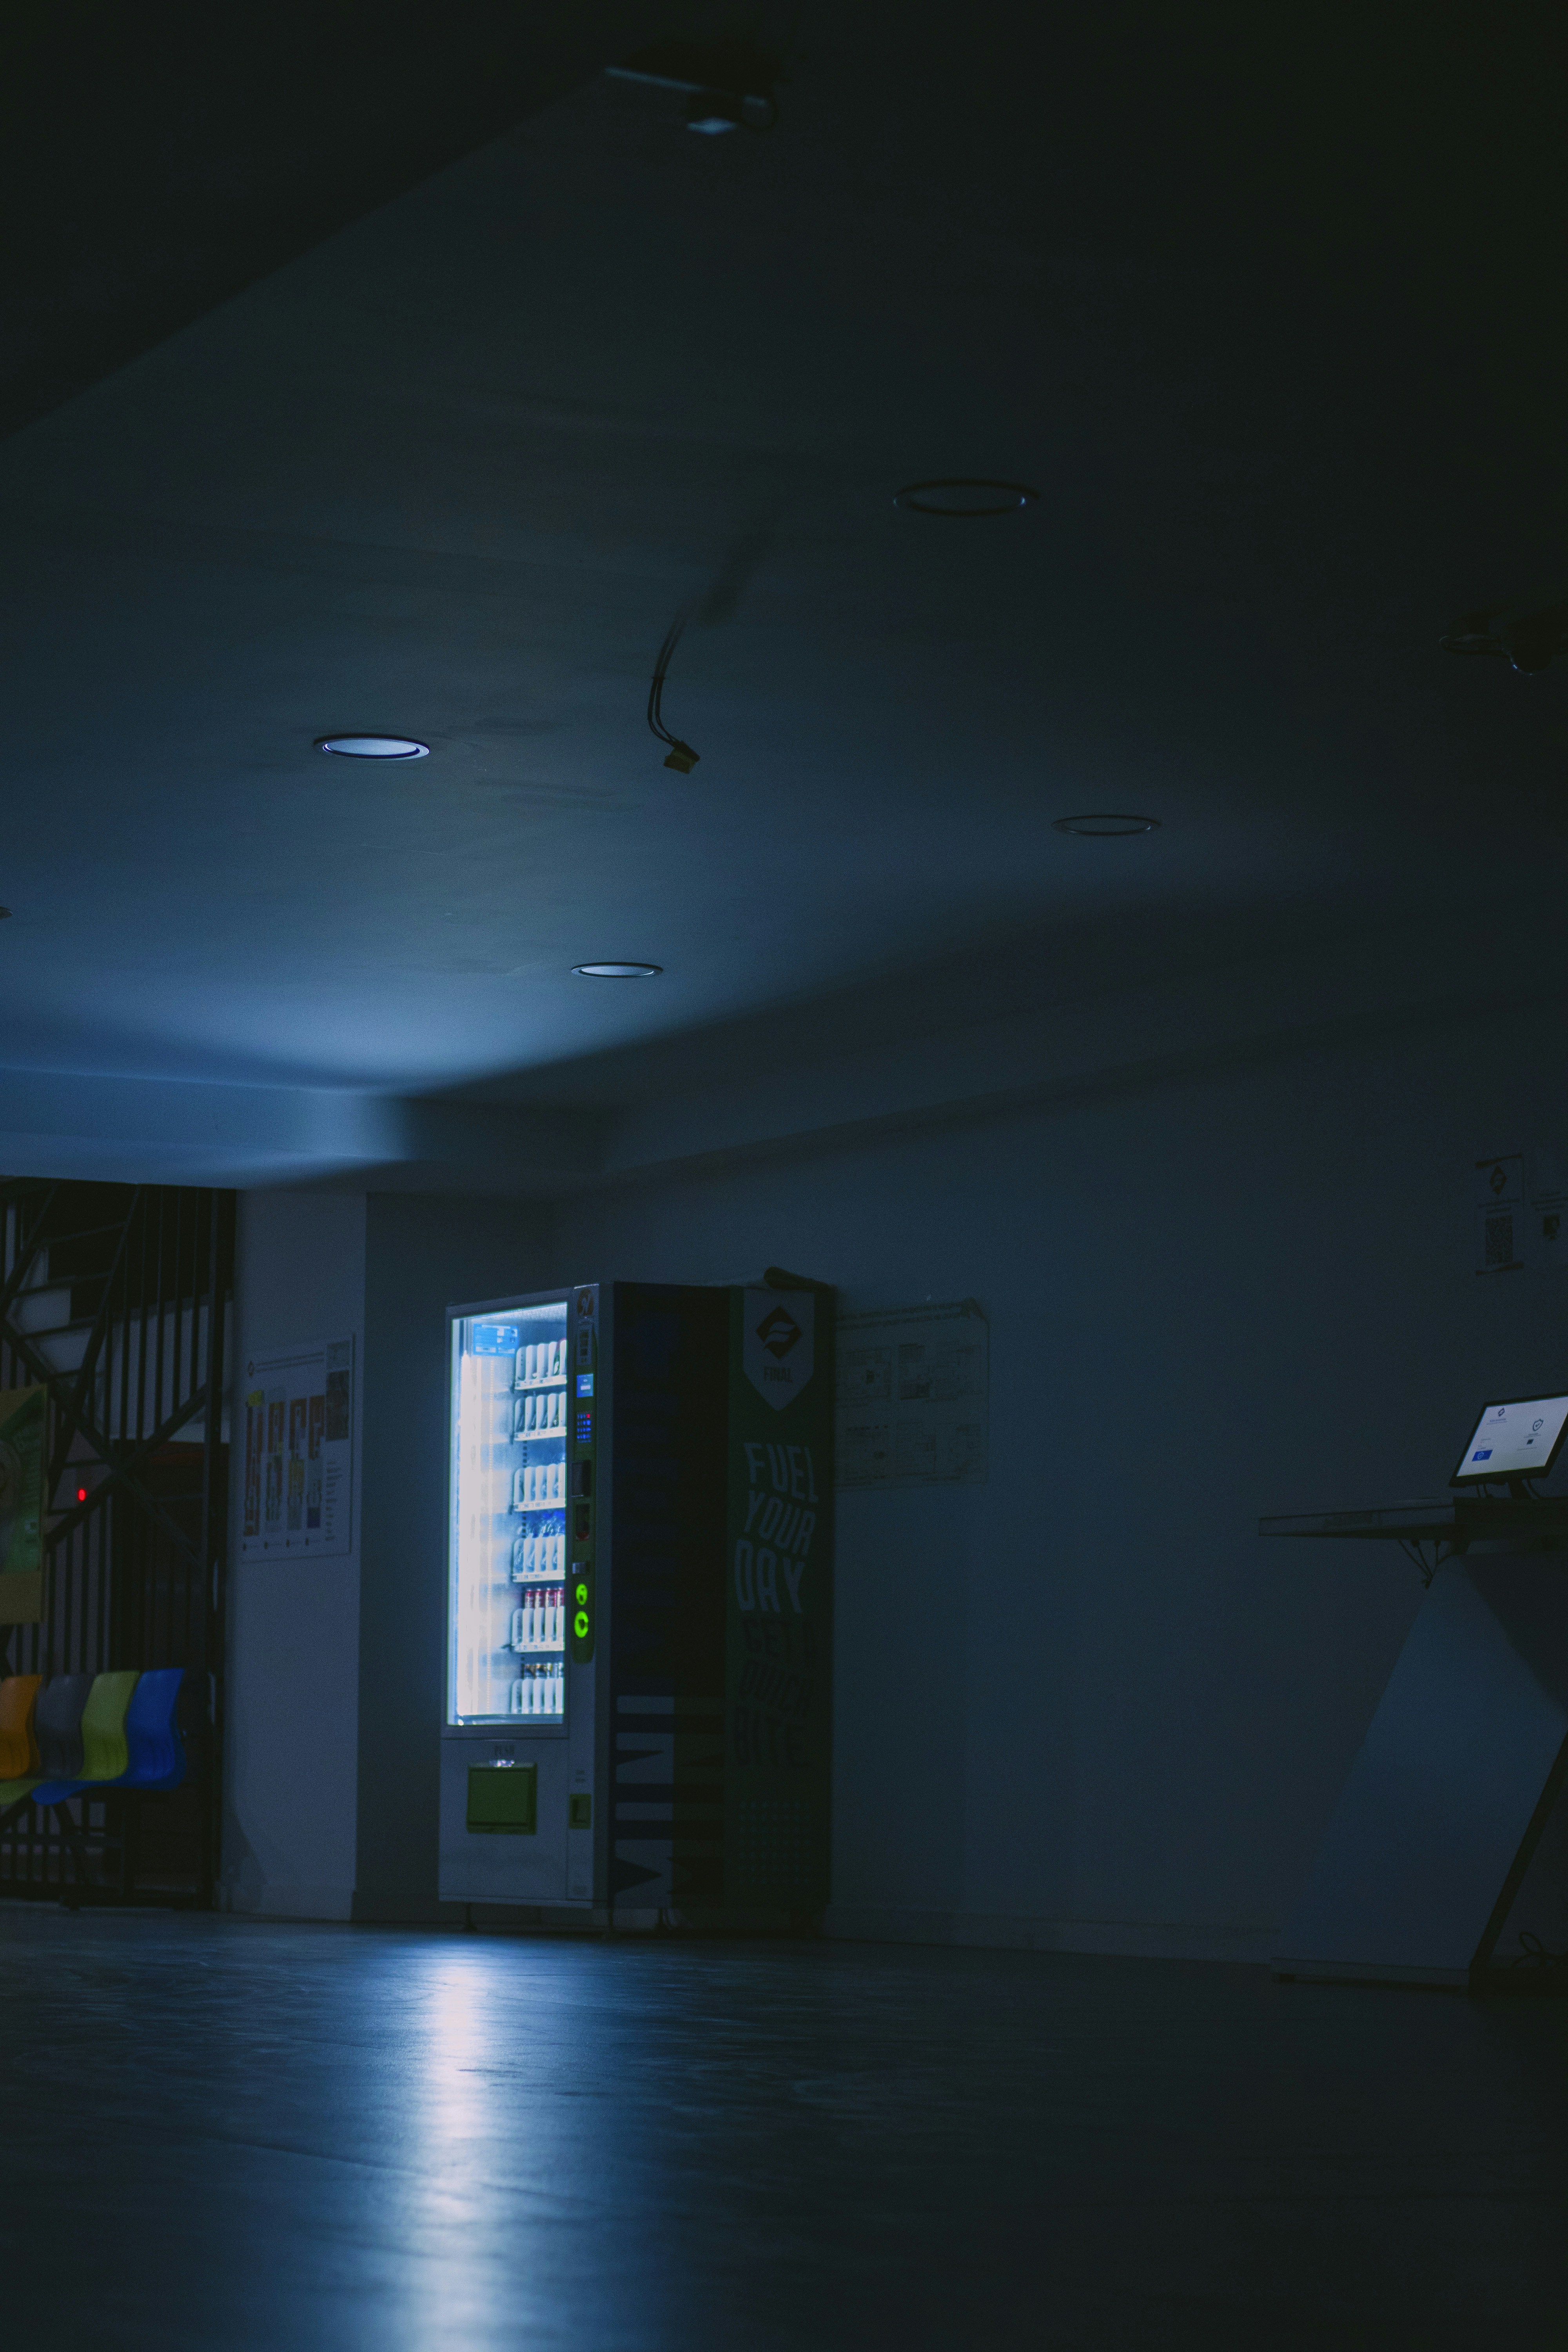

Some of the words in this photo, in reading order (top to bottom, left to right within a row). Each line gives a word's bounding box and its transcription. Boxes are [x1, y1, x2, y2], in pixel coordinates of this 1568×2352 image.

[763, 1366, 793, 1383] FINAL
[743, 1442, 819, 1503] FUEL
[744, 1490, 816, 1556] YOUR
[734, 1538, 804, 1613] DAY
[742, 1617, 793, 1660] GET
[739, 1659, 814, 1717] QUICK
[733, 1706, 810, 1769] BITE
[616, 1696, 723, 1908] MINI
